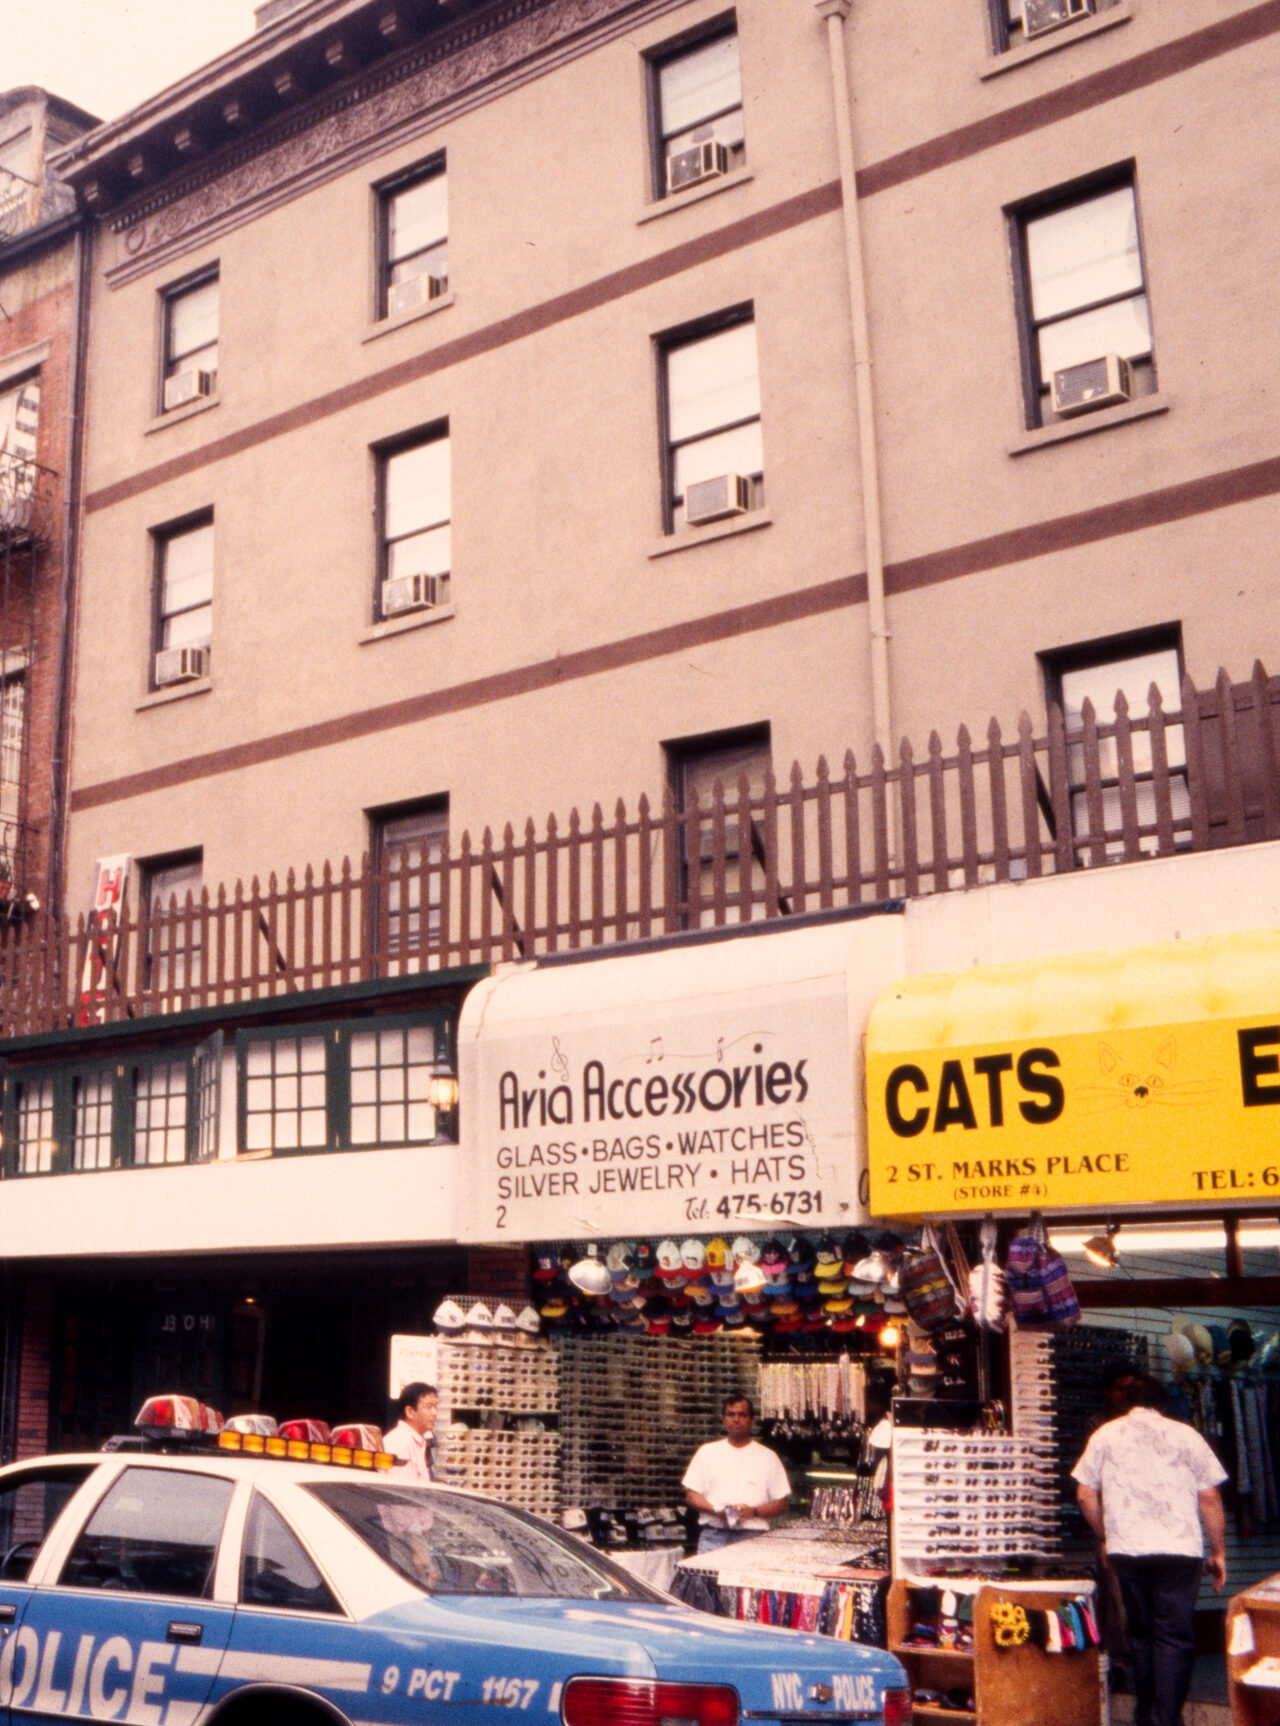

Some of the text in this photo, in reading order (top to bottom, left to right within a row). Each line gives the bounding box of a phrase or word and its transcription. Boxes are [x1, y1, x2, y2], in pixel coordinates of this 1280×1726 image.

[499, 1042, 808, 1131] Aria Accessories
[885, 1047, 1066, 1138] CATS
[496, 1121, 804, 1169] GLASS BAGS WATCHES
[498, 1155, 807, 1200] SILVER JEWELRY HATS
[885, 1152, 1131, 1184] 2 ST. MARKS PLACE
[1192, 1168, 1257, 1191] TEL:
[716, 1189, 823, 1220] 475-6731
[952, 1183, 1048, 1201] (STORE #4)
[495, 1205, 508, 1230] 2
[380, 1664, 540, 1710] 9 PCT 1167
[771, 1671, 878, 1711] NYC POLICE
